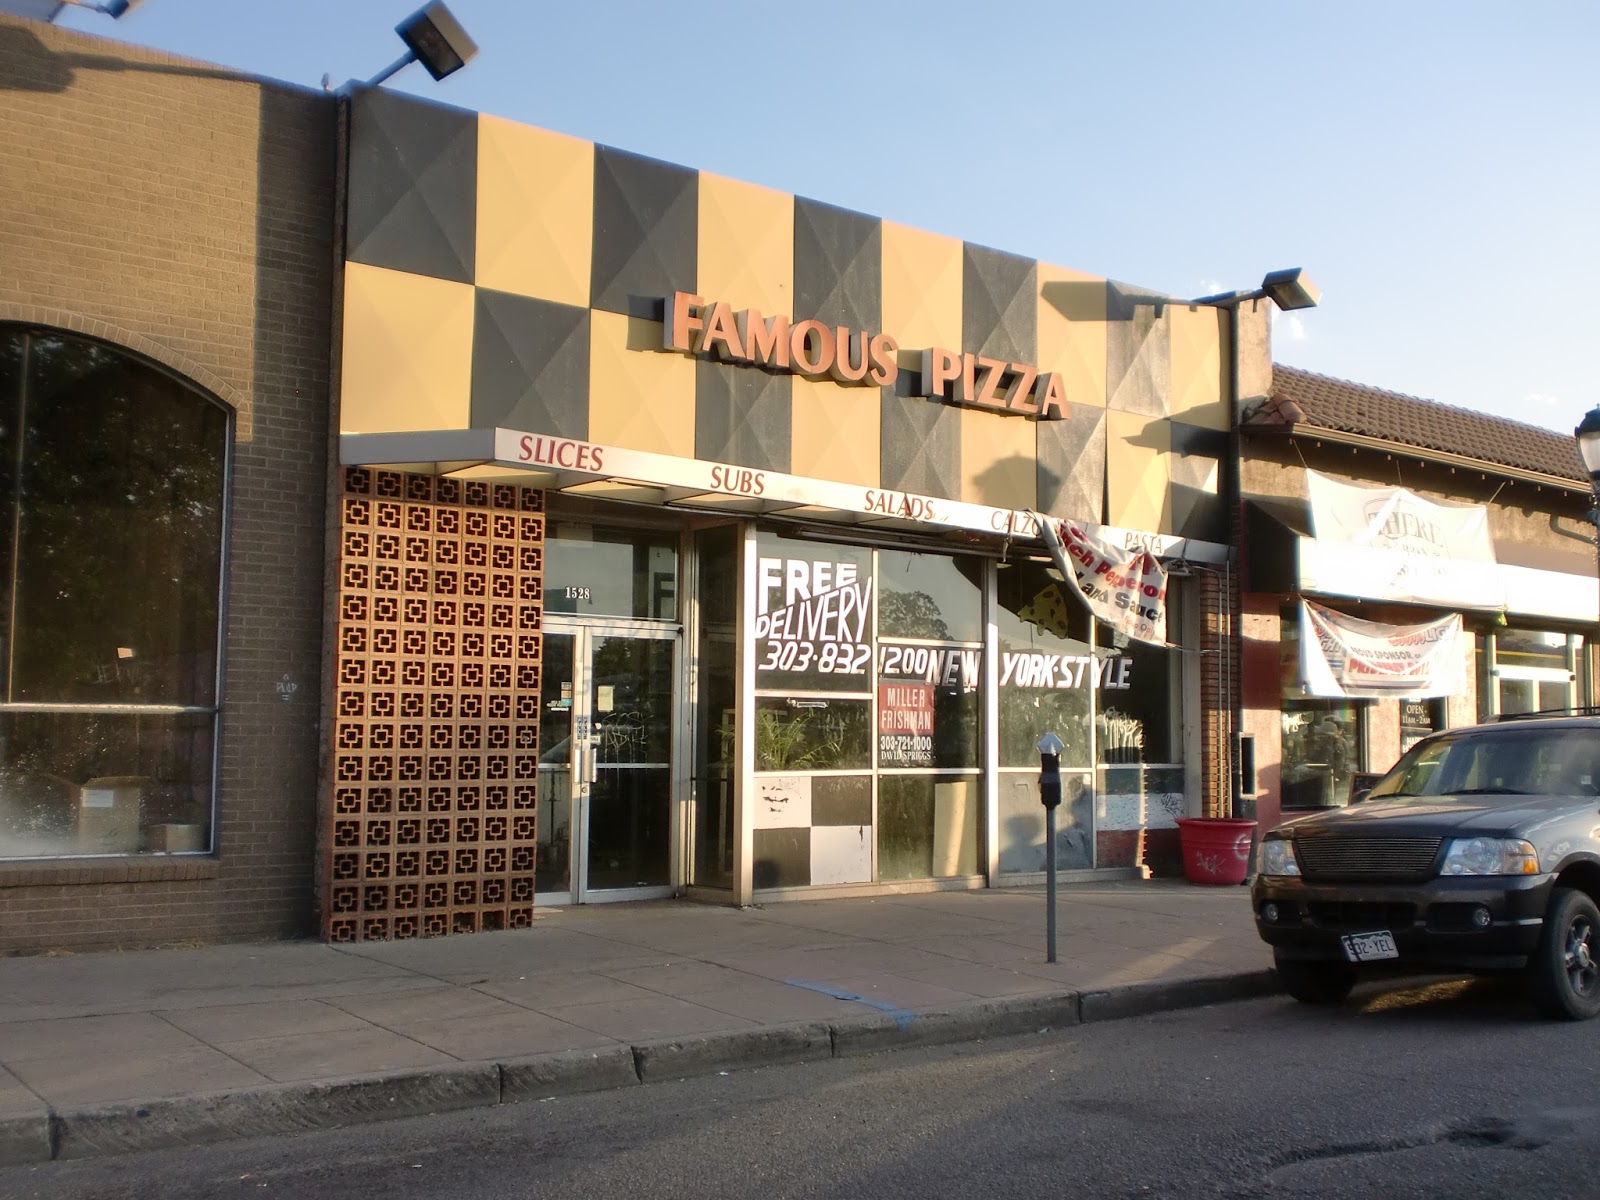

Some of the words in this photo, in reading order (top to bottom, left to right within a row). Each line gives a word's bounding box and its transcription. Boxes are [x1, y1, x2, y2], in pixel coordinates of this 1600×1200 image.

[666, 290, 898, 387] FAMOUS
[923, 347, 1071, 420] PIZZA
[518, 435, 603, 472] SLICES
[710, 465, 765, 495] SUBS
[864, 489, 934, 520] SALADS
[565, 587, 590, 600] 1528
[759, 557, 857, 616] FREE
[755, 576, 872, 643] DELIVERY
[878, 646, 929, 675] 1200
[924, 649, 982, 688] NEW
[1374, 649, 1413, 661] SPONSOR
[887, 688, 925, 707] MILLER
[1406, 704, 1424, 715] OPEN
[881, 710, 931, 730] FRISHMAN
[881, 750, 901, 760] DAVID
[904, 751, 932, 760] SPRIGGS
